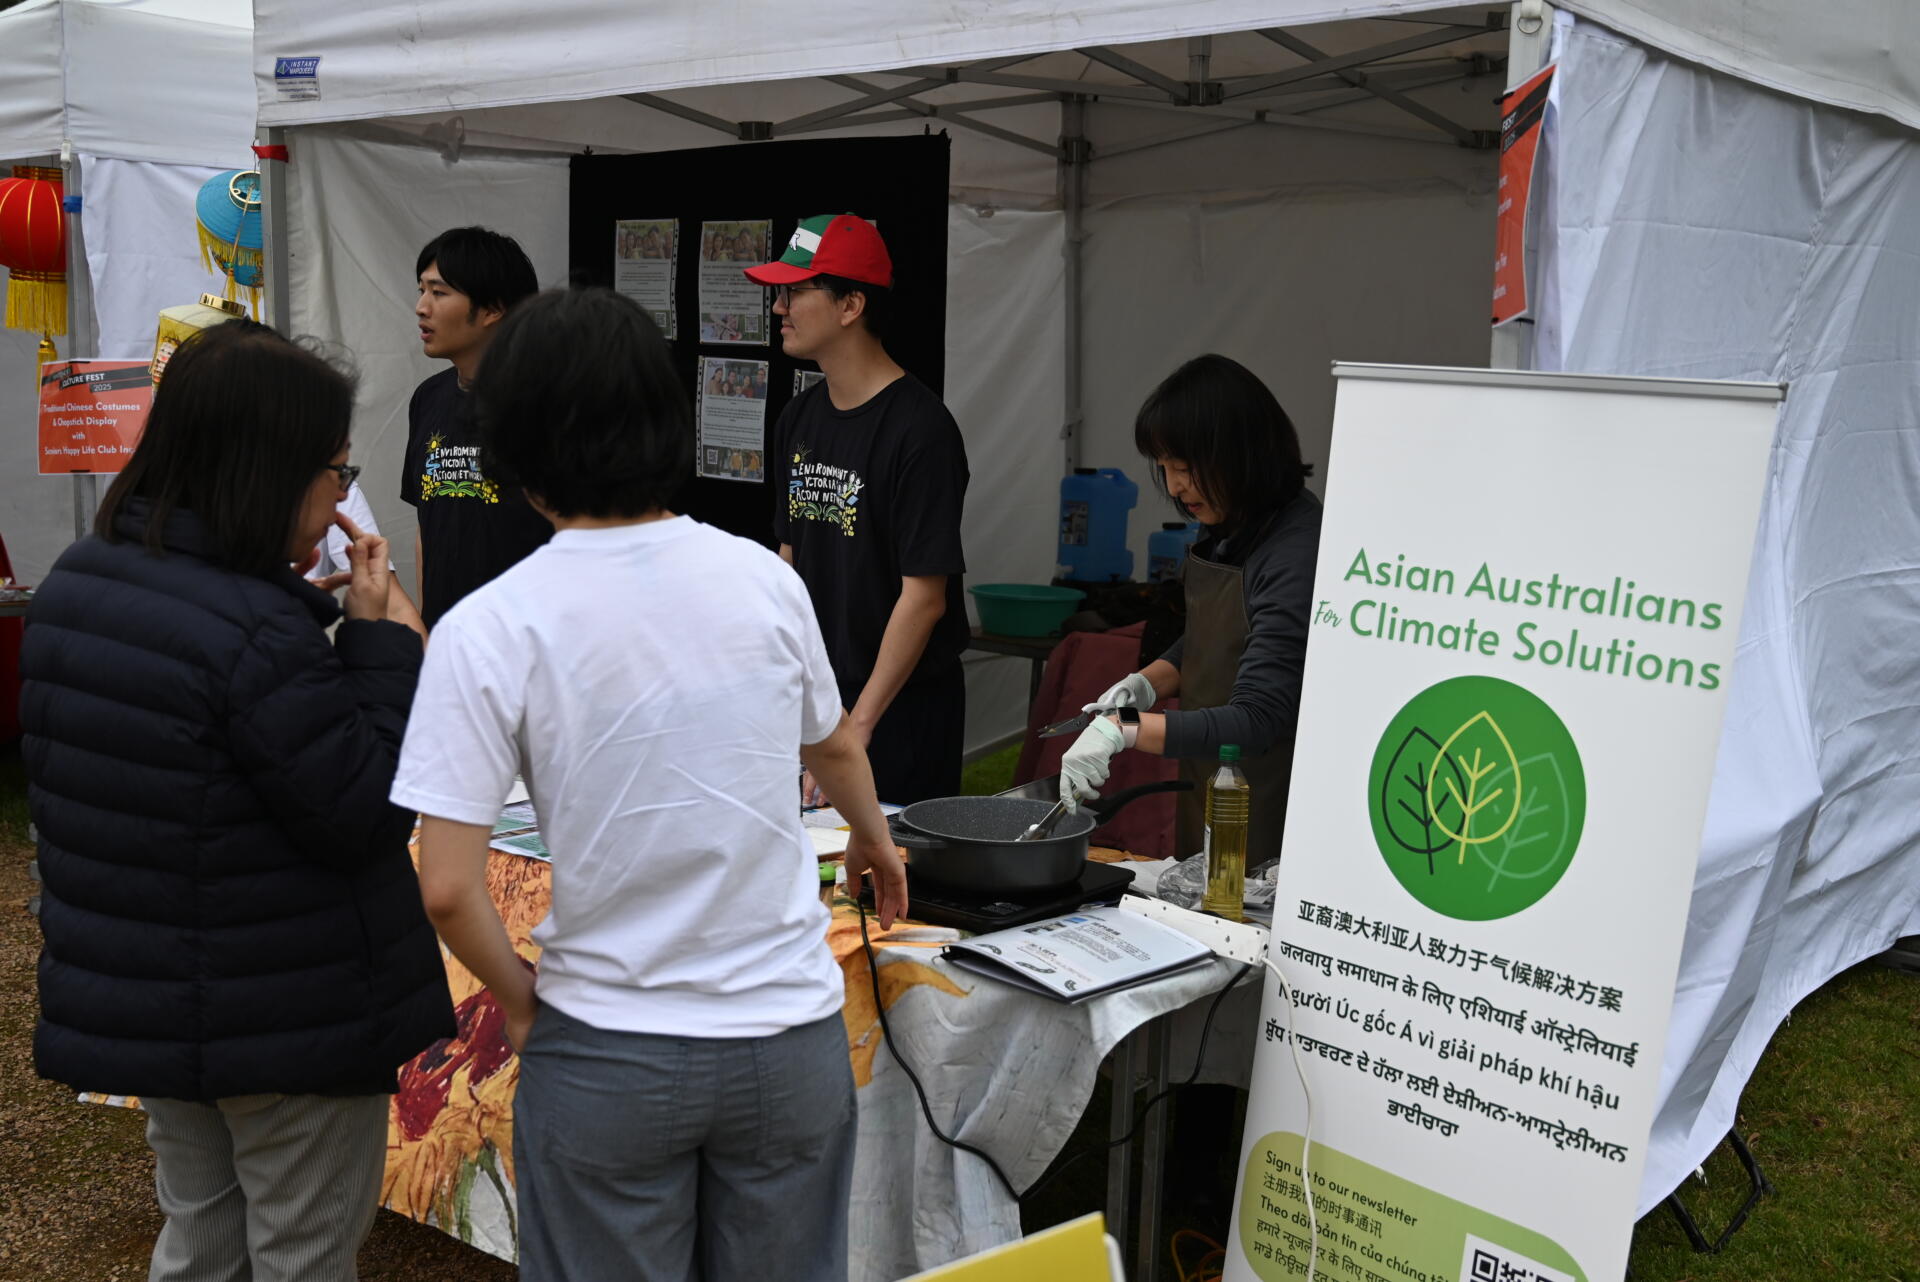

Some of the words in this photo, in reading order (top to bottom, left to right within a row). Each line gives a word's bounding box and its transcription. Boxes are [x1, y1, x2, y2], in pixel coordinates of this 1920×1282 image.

[290, 60, 317, 68] INSTANT
[66, 402, 94, 412] Chinese
[95, 401, 141, 411] Costumes
[86, 373, 105, 382] FEST
[93, 383, 112, 392] 2025
[58, 417, 84, 428] Chopstick
[86, 416, 118, 427] Display
[63, 446, 81, 457] Happy
[81, 445, 96, 455] Life
[97, 444, 117, 455] Club
[71, 431, 86, 440] with
[1344, 547, 1455, 595] Asian
[1465, 562, 1724, 630] Australians
[1313, 599, 1342, 629] For
[1349, 599, 1500, 656] Climate
[1513, 621, 1722, 690] Solutions
[1298, 899, 1624, 1012] 亚裔澳大利亚人致力于气候解决方案
[1280, 941, 1333, 977] जलवायु
[1337, 959, 1399, 992] समाधान
[1402, 974, 1419, 998] के
[1422, 980, 1455, 1015] लिए
[1459, 996, 1527, 1034] एशियाई
[1531, 1017, 1639, 1068] ऑस्ट्रेलियाई
[1278, 982, 1332, 1013] Người
[1336, 998, 1360, 1023] Úc
[1363, 1009, 1396, 1035] gốc
[1400, 1019, 1413, 1042] Á
[1418, 1030, 1434, 1050] vì
[1438, 1037, 1476, 1063] giải
[1479, 1052, 1534, 1084] pháp
[1539, 1067, 1573, 1095] khí
[1575, 1079, 1620, 1110] hậu
[1288, 1030, 1353, 1066] ਾਤਾਵਰਣ
[1357, 1050, 1370, 1073] ਦੇ
[1406, 1073, 1439, 1099] ਲਈ
[1263, 1171, 1382, 1239] 注册我们的时事通讯
[1265, 1150, 1291, 1173] Sign
[1313, 1171, 1326, 1187] to
[1328, 1181, 1350, 1197] our
[1352, 1191, 1418, 1227] newsletter
[1257, 1218, 1281, 1239] हमारे
[1329, 1249, 1340, 1266] के
[1341, 1254, 1363, 1281] लिए
[1260, 1194, 1288, 1219] Theo
[1291, 1210, 1311, 1229] dõi
[1315, 1218, 1338, 1243] bản
[1341, 1233, 1357, 1252] tin
[1360, 1243, 1383, 1263] của
